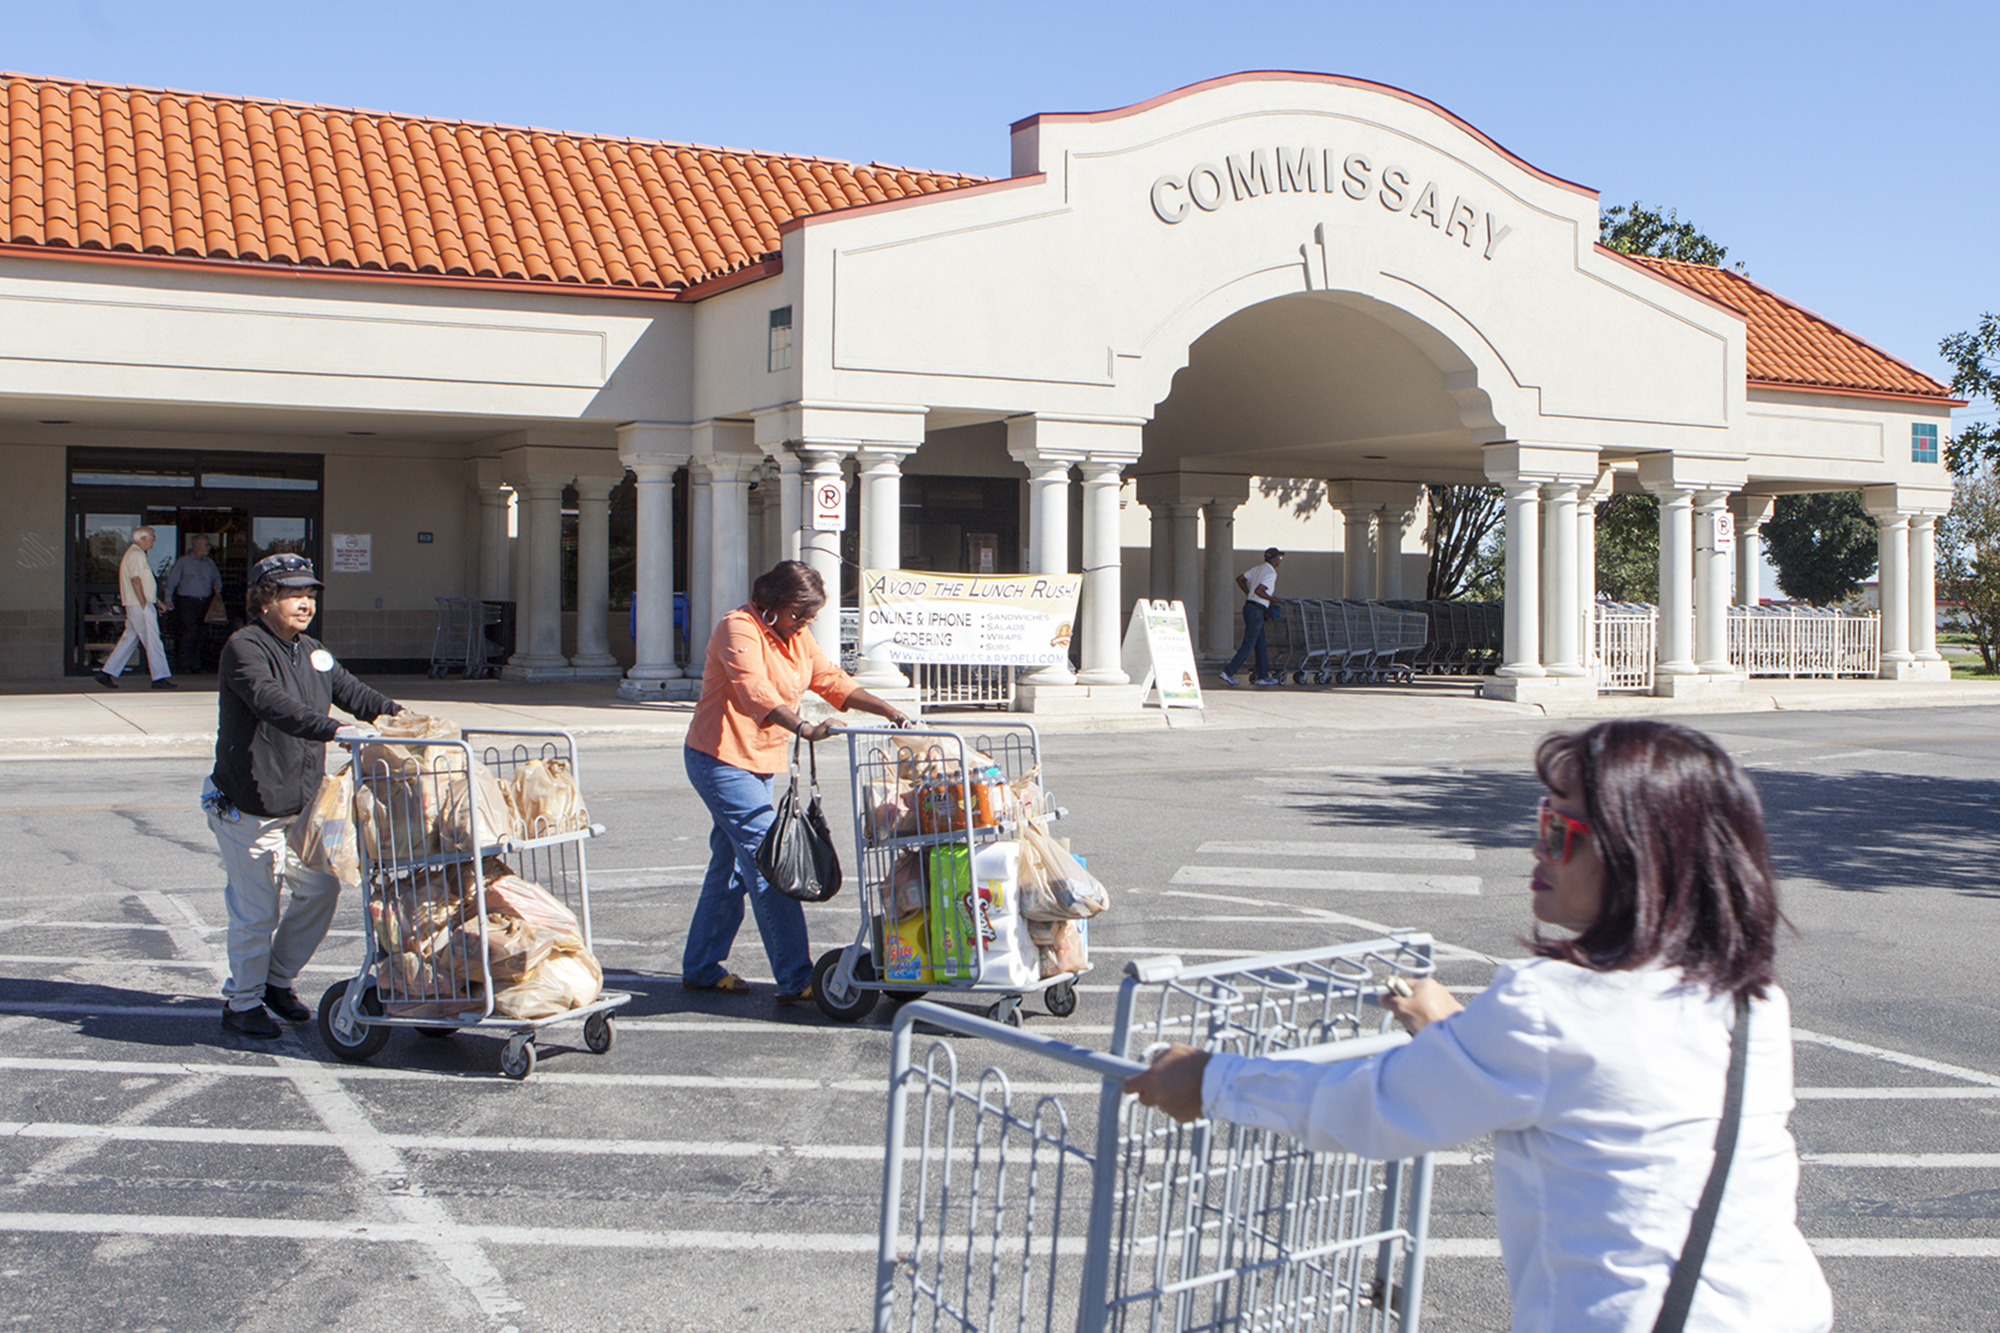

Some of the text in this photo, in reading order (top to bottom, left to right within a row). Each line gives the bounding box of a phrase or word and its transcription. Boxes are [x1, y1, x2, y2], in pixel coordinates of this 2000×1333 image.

[1150, 146, 1514, 261] COMMISSARY
[868, 575, 1078, 599] AVOID THE LUNCH RUSH!
[869, 610, 972, 628] ONLINE & IPHONE
[986, 613, 1051, 622] SANDWICHES
[986, 623, 1026, 632] SALADS
[893, 631, 953, 647] ORDERING
[985, 633, 1023, 641] WRAPS
[985, 643, 1012, 652] SUBS
